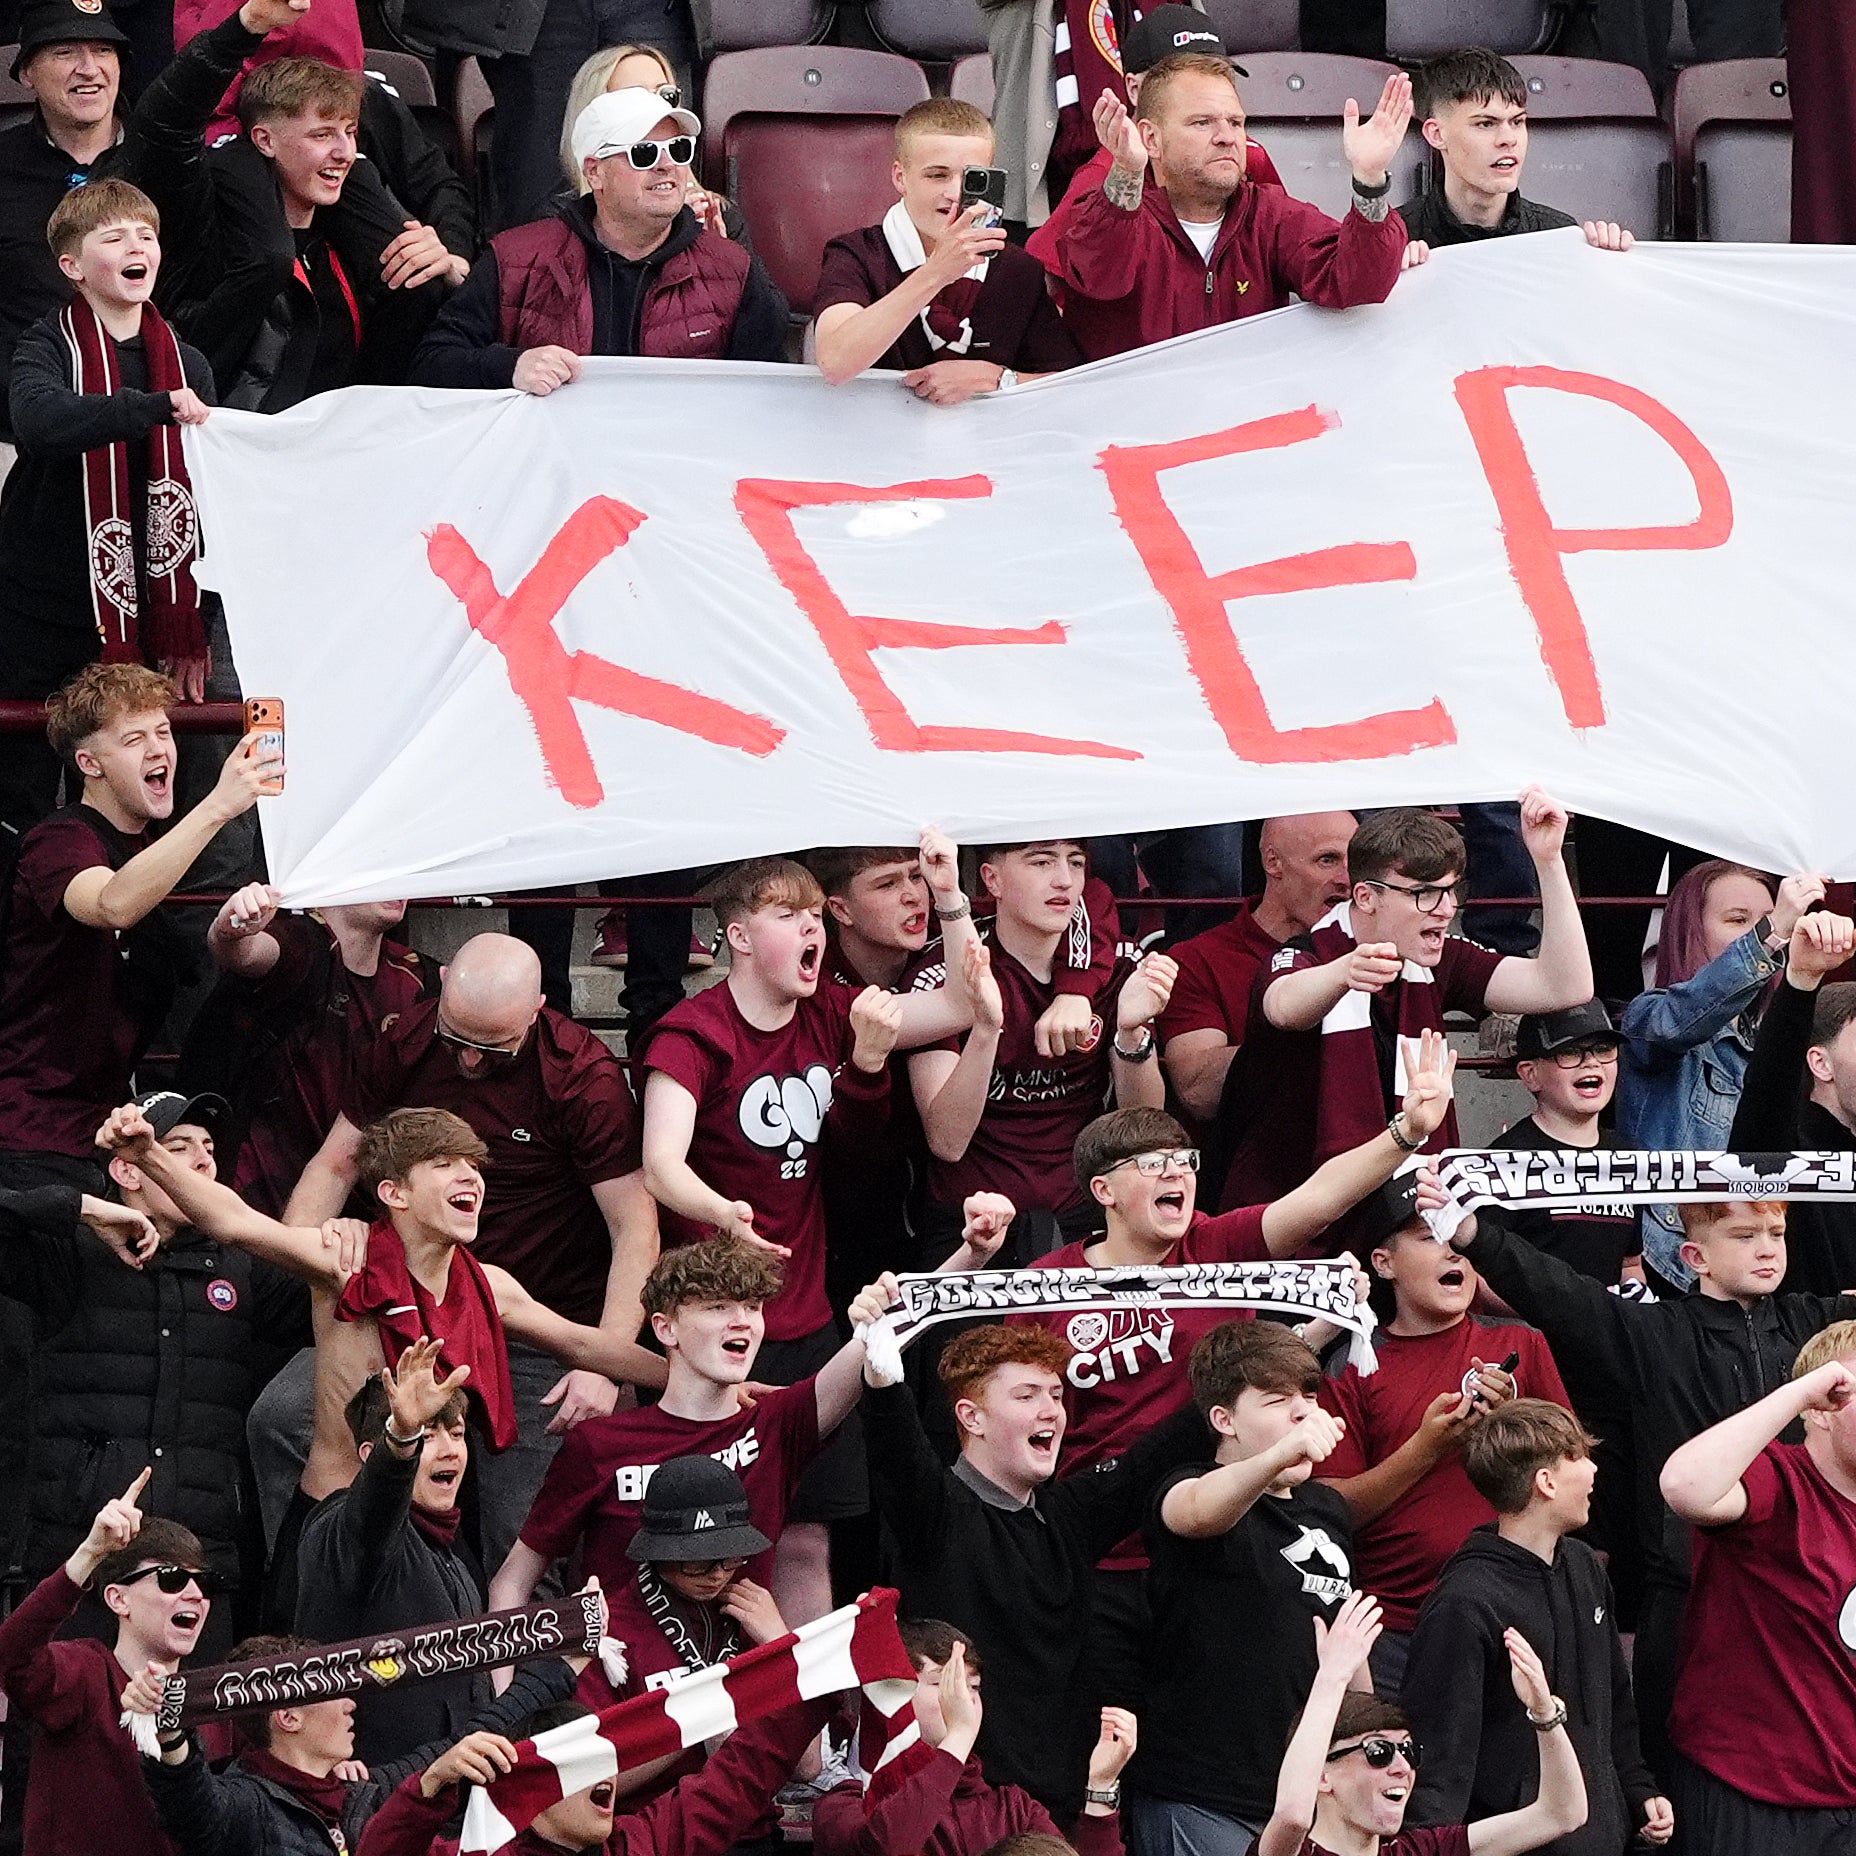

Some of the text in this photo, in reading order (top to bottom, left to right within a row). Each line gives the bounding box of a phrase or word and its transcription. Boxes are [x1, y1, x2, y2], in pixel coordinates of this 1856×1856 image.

[428, 366, 1732, 806] KEEP
[780, 1159, 807, 1180] 22
[1452, 1150, 1699, 1198] ULTRAS
[900, 1261, 1359, 1323] GORGIE ULTRAS
[1067, 1324, 1174, 1389] CITY
[1307, 1574, 1350, 1597] ULTRA
[409, 1608, 565, 1677] ULTRAS
